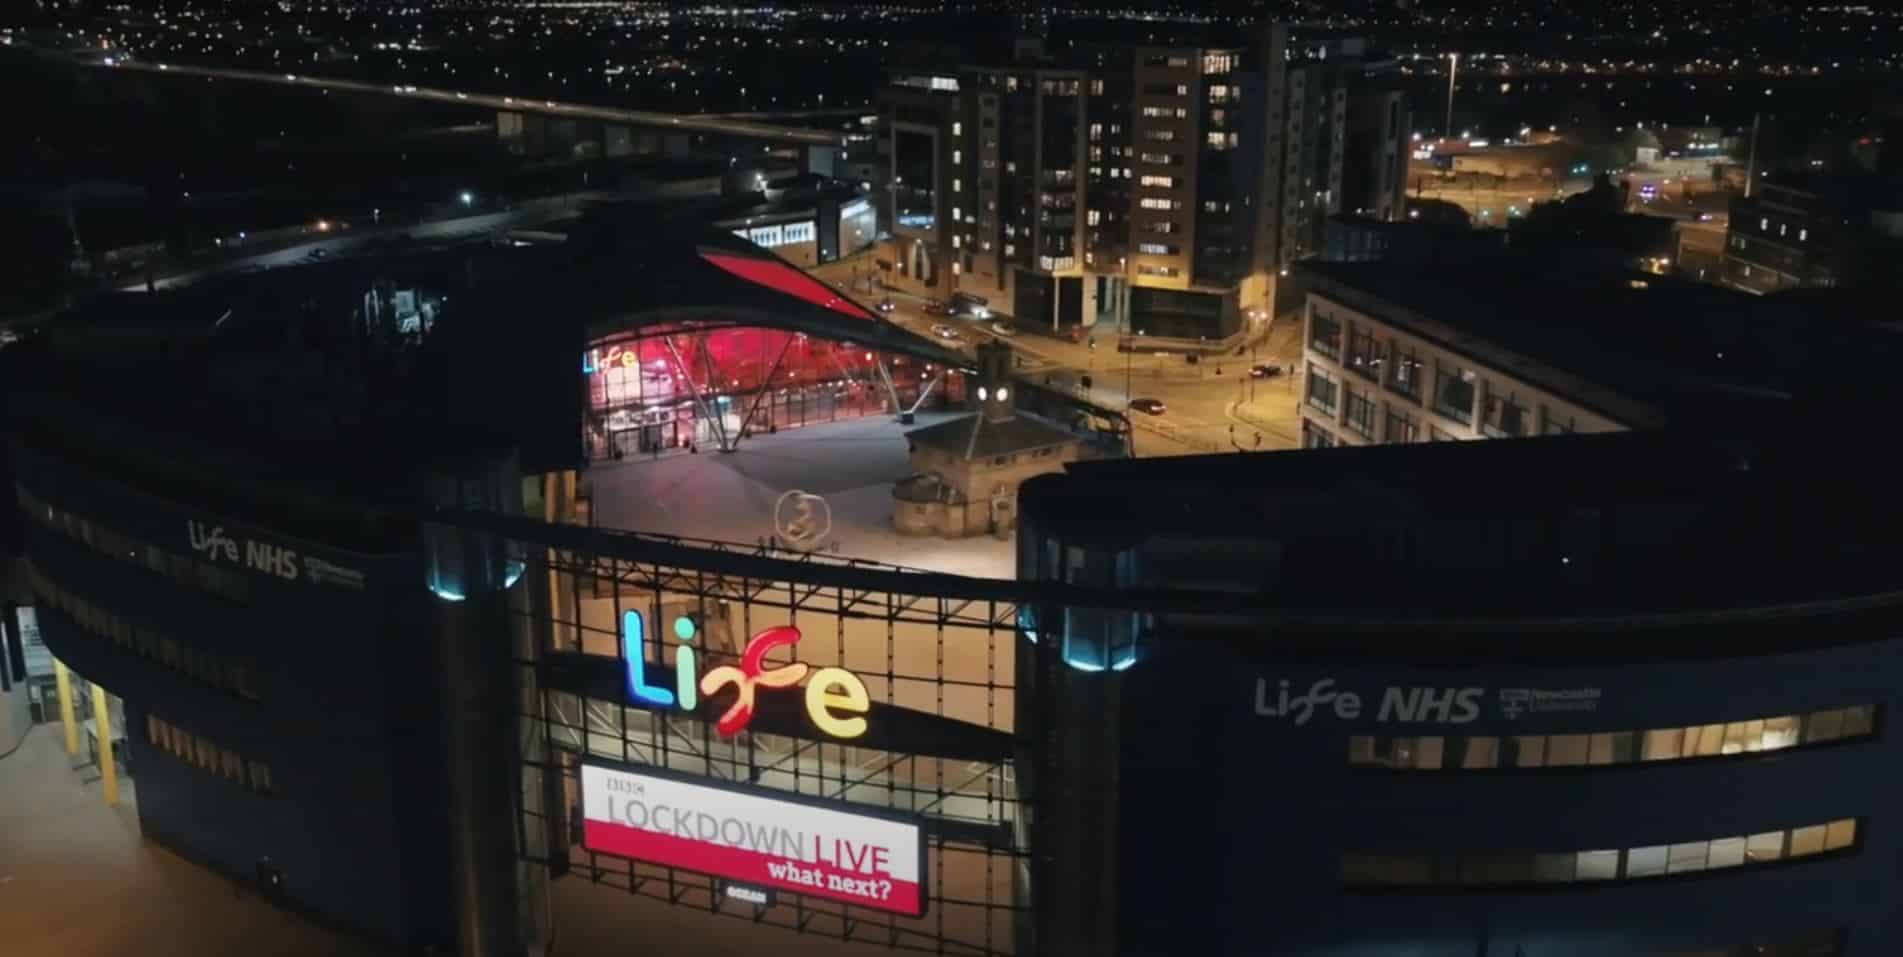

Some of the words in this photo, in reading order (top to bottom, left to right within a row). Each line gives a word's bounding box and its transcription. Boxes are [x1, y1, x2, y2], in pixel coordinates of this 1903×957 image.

[583, 346, 636, 374] Life
[188, 519, 241, 562] Life
[247, 540, 298, 580] NHS
[622, 608, 872, 738] Life
[1255, 677, 1361, 725] Life
[1377, 687, 1485, 723] NHS
[608, 795, 803, 859] LOCKDOWN
[815, 835, 889, 874] LIVE
[767, 861, 824, 888] what
[828, 873, 892, 900] next?
